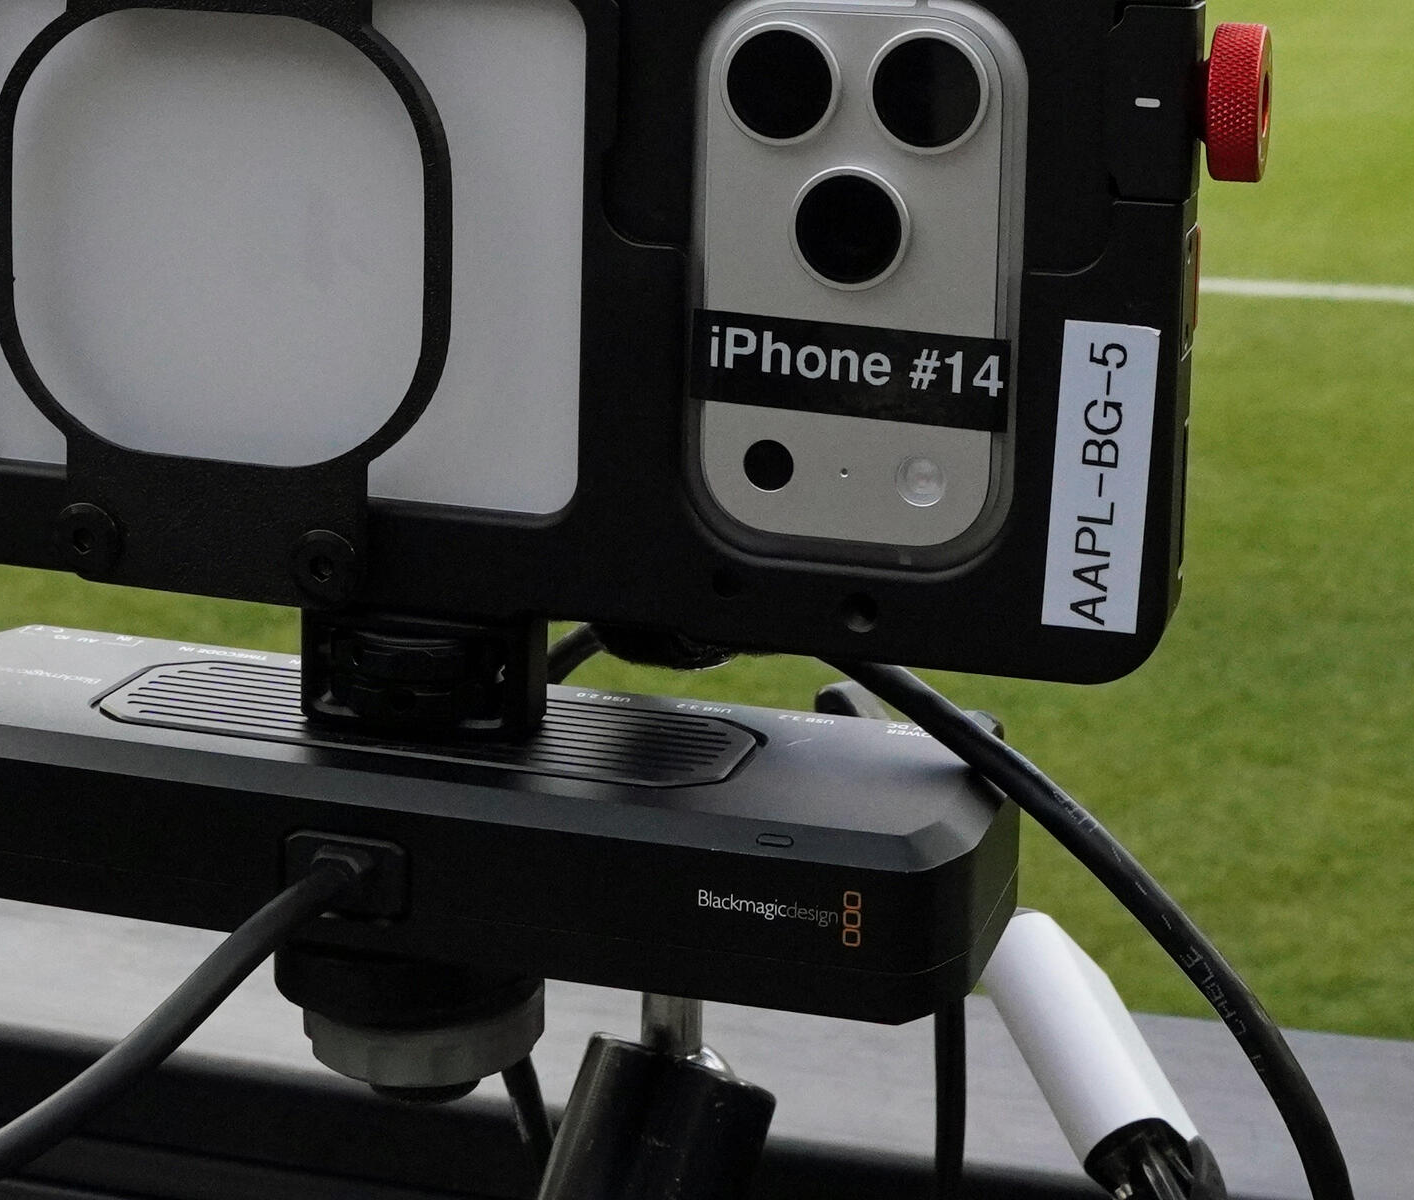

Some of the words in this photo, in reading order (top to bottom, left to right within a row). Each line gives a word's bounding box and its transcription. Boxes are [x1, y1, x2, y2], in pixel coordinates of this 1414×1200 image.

[709, 326, 892, 386] iPhone
[909, 348, 1004, 397] #14
[1069, 341, 1129, 626] AAPL-BG-5
[178, 645, 196, 653] IN
[197, 648, 267, 661] TIMECODE
[602, 695, 631, 703] USB
[676, 703, 700, 711] 3.2
[702, 706, 732, 714] USB
[804, 717, 835, 725] USB
[887, 729, 932, 738] OWER
[697, 889, 838, 927] Blackmagicdesign
